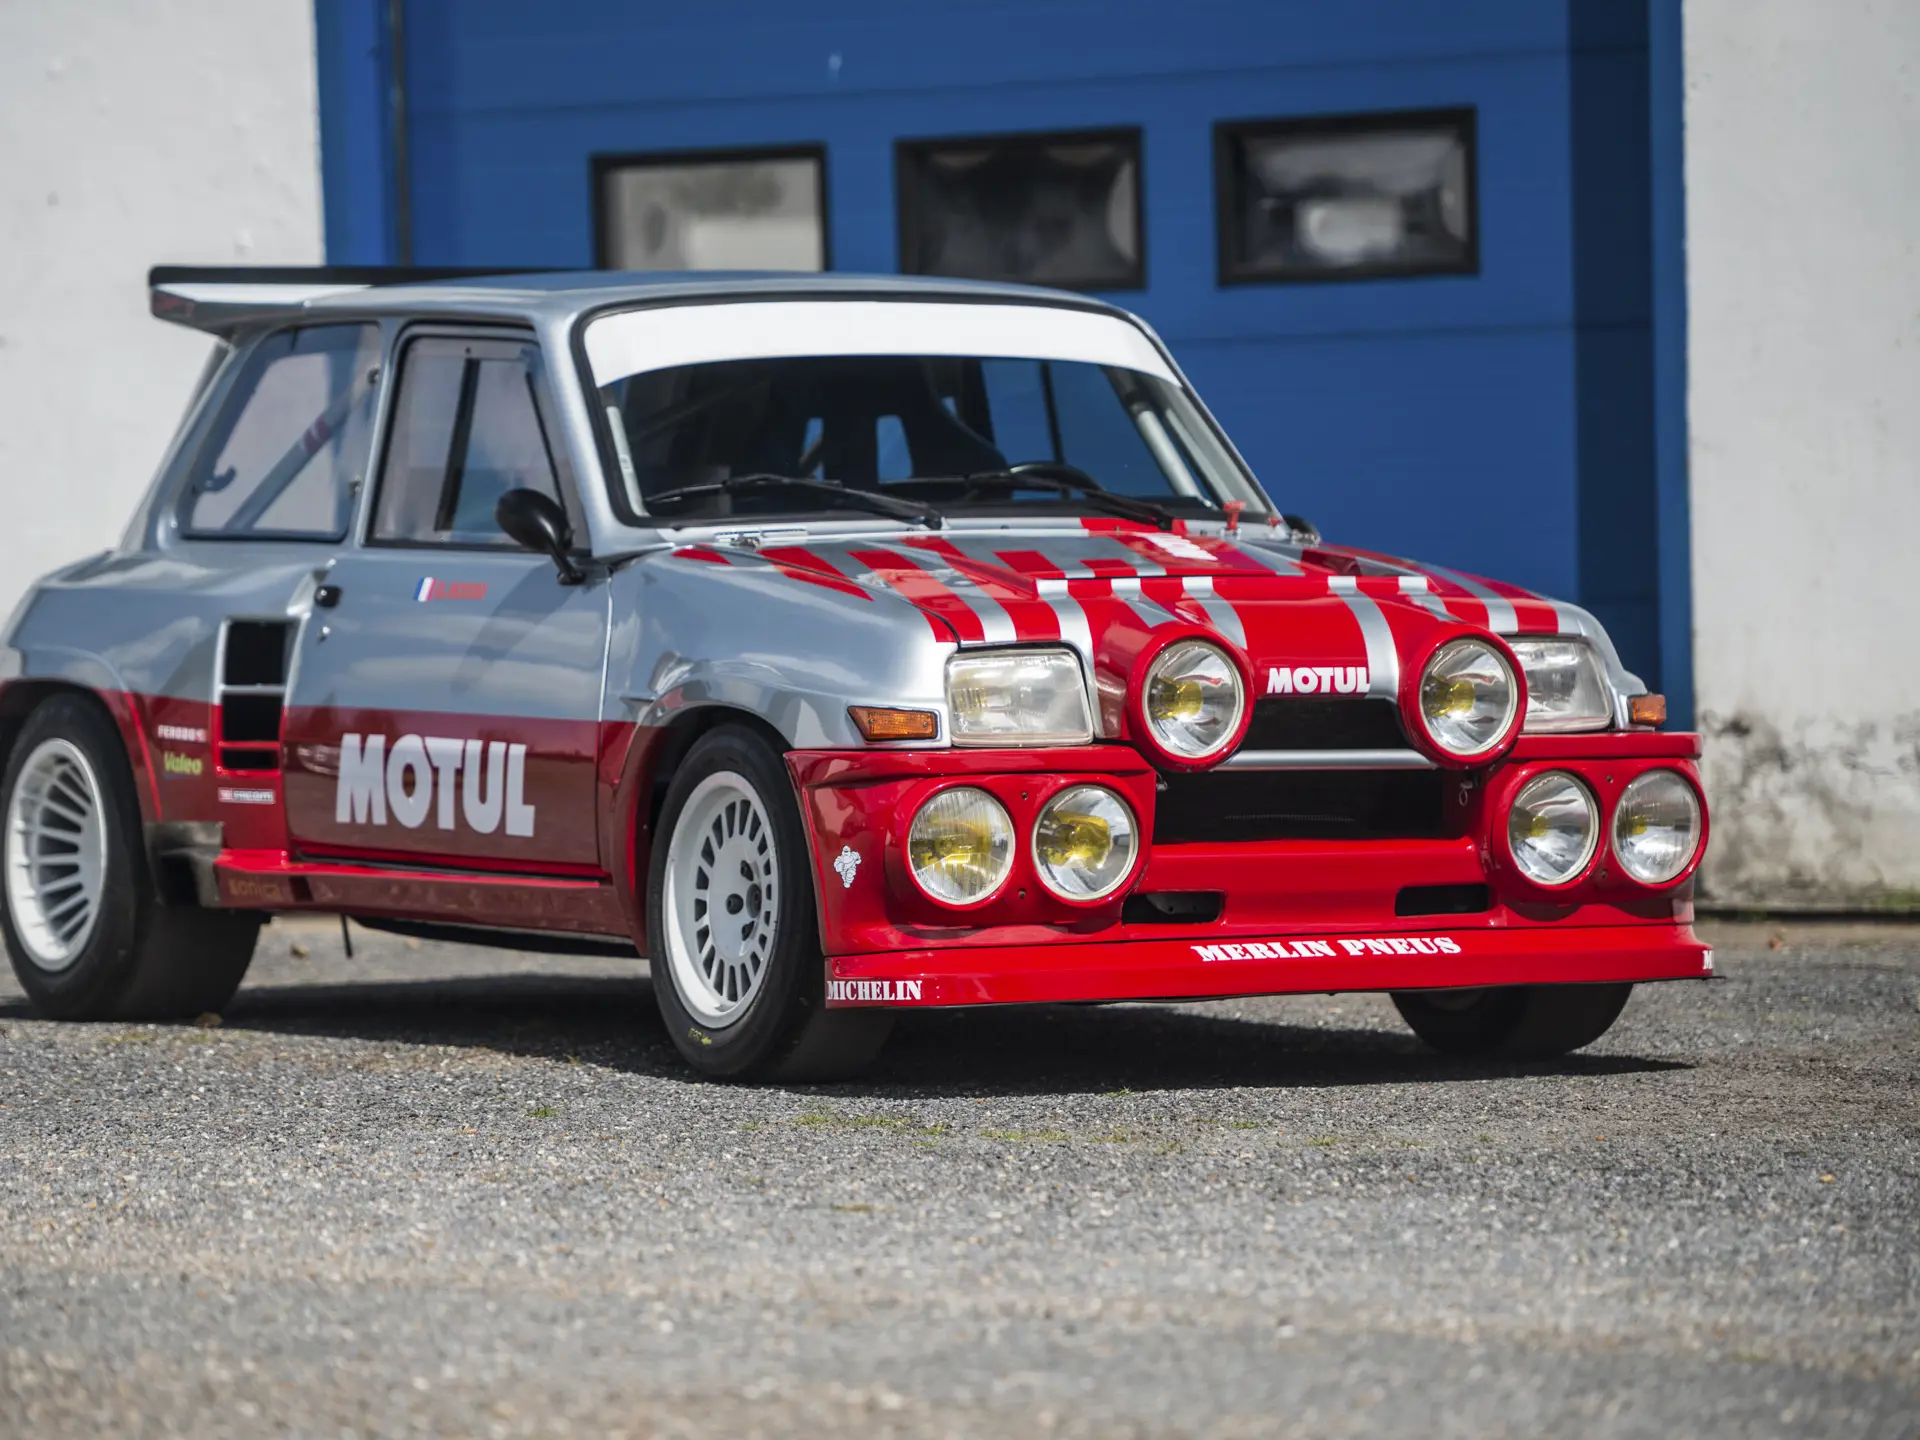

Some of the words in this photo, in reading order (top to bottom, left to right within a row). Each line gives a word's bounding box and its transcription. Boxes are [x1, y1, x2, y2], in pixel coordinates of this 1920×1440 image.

[1266, 667, 1371, 694] MOTUL
[335, 733, 535, 838] MOTUL
[1191, 940, 1337, 962] MERLIN
[1337, 936, 1462, 956] PNEUS
[827, 980, 922, 1001] MICHELIN
